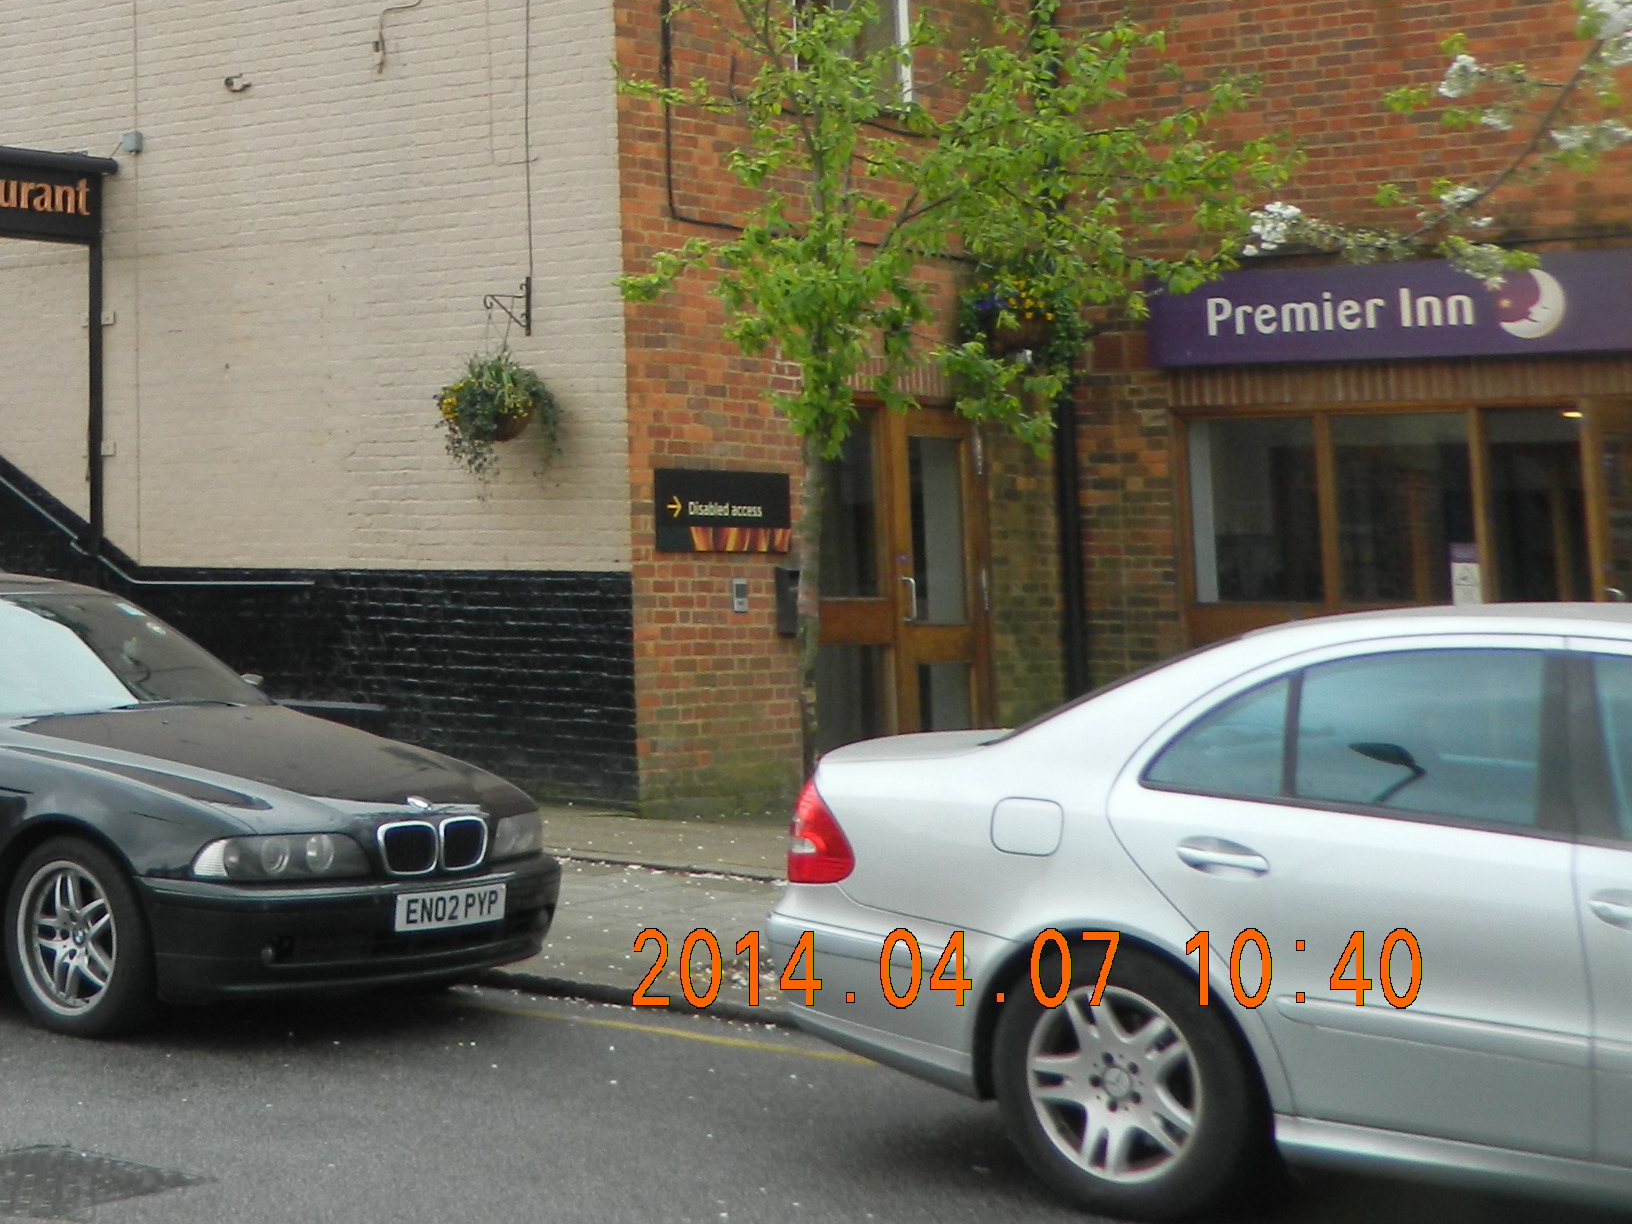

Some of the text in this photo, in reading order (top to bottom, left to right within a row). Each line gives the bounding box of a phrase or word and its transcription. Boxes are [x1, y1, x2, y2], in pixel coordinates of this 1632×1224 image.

[1206, 287, 1475, 337] Premier Inn
[688, 501, 763, 518] Disabled access
[406, 890, 499, 925] EN02 PYP
